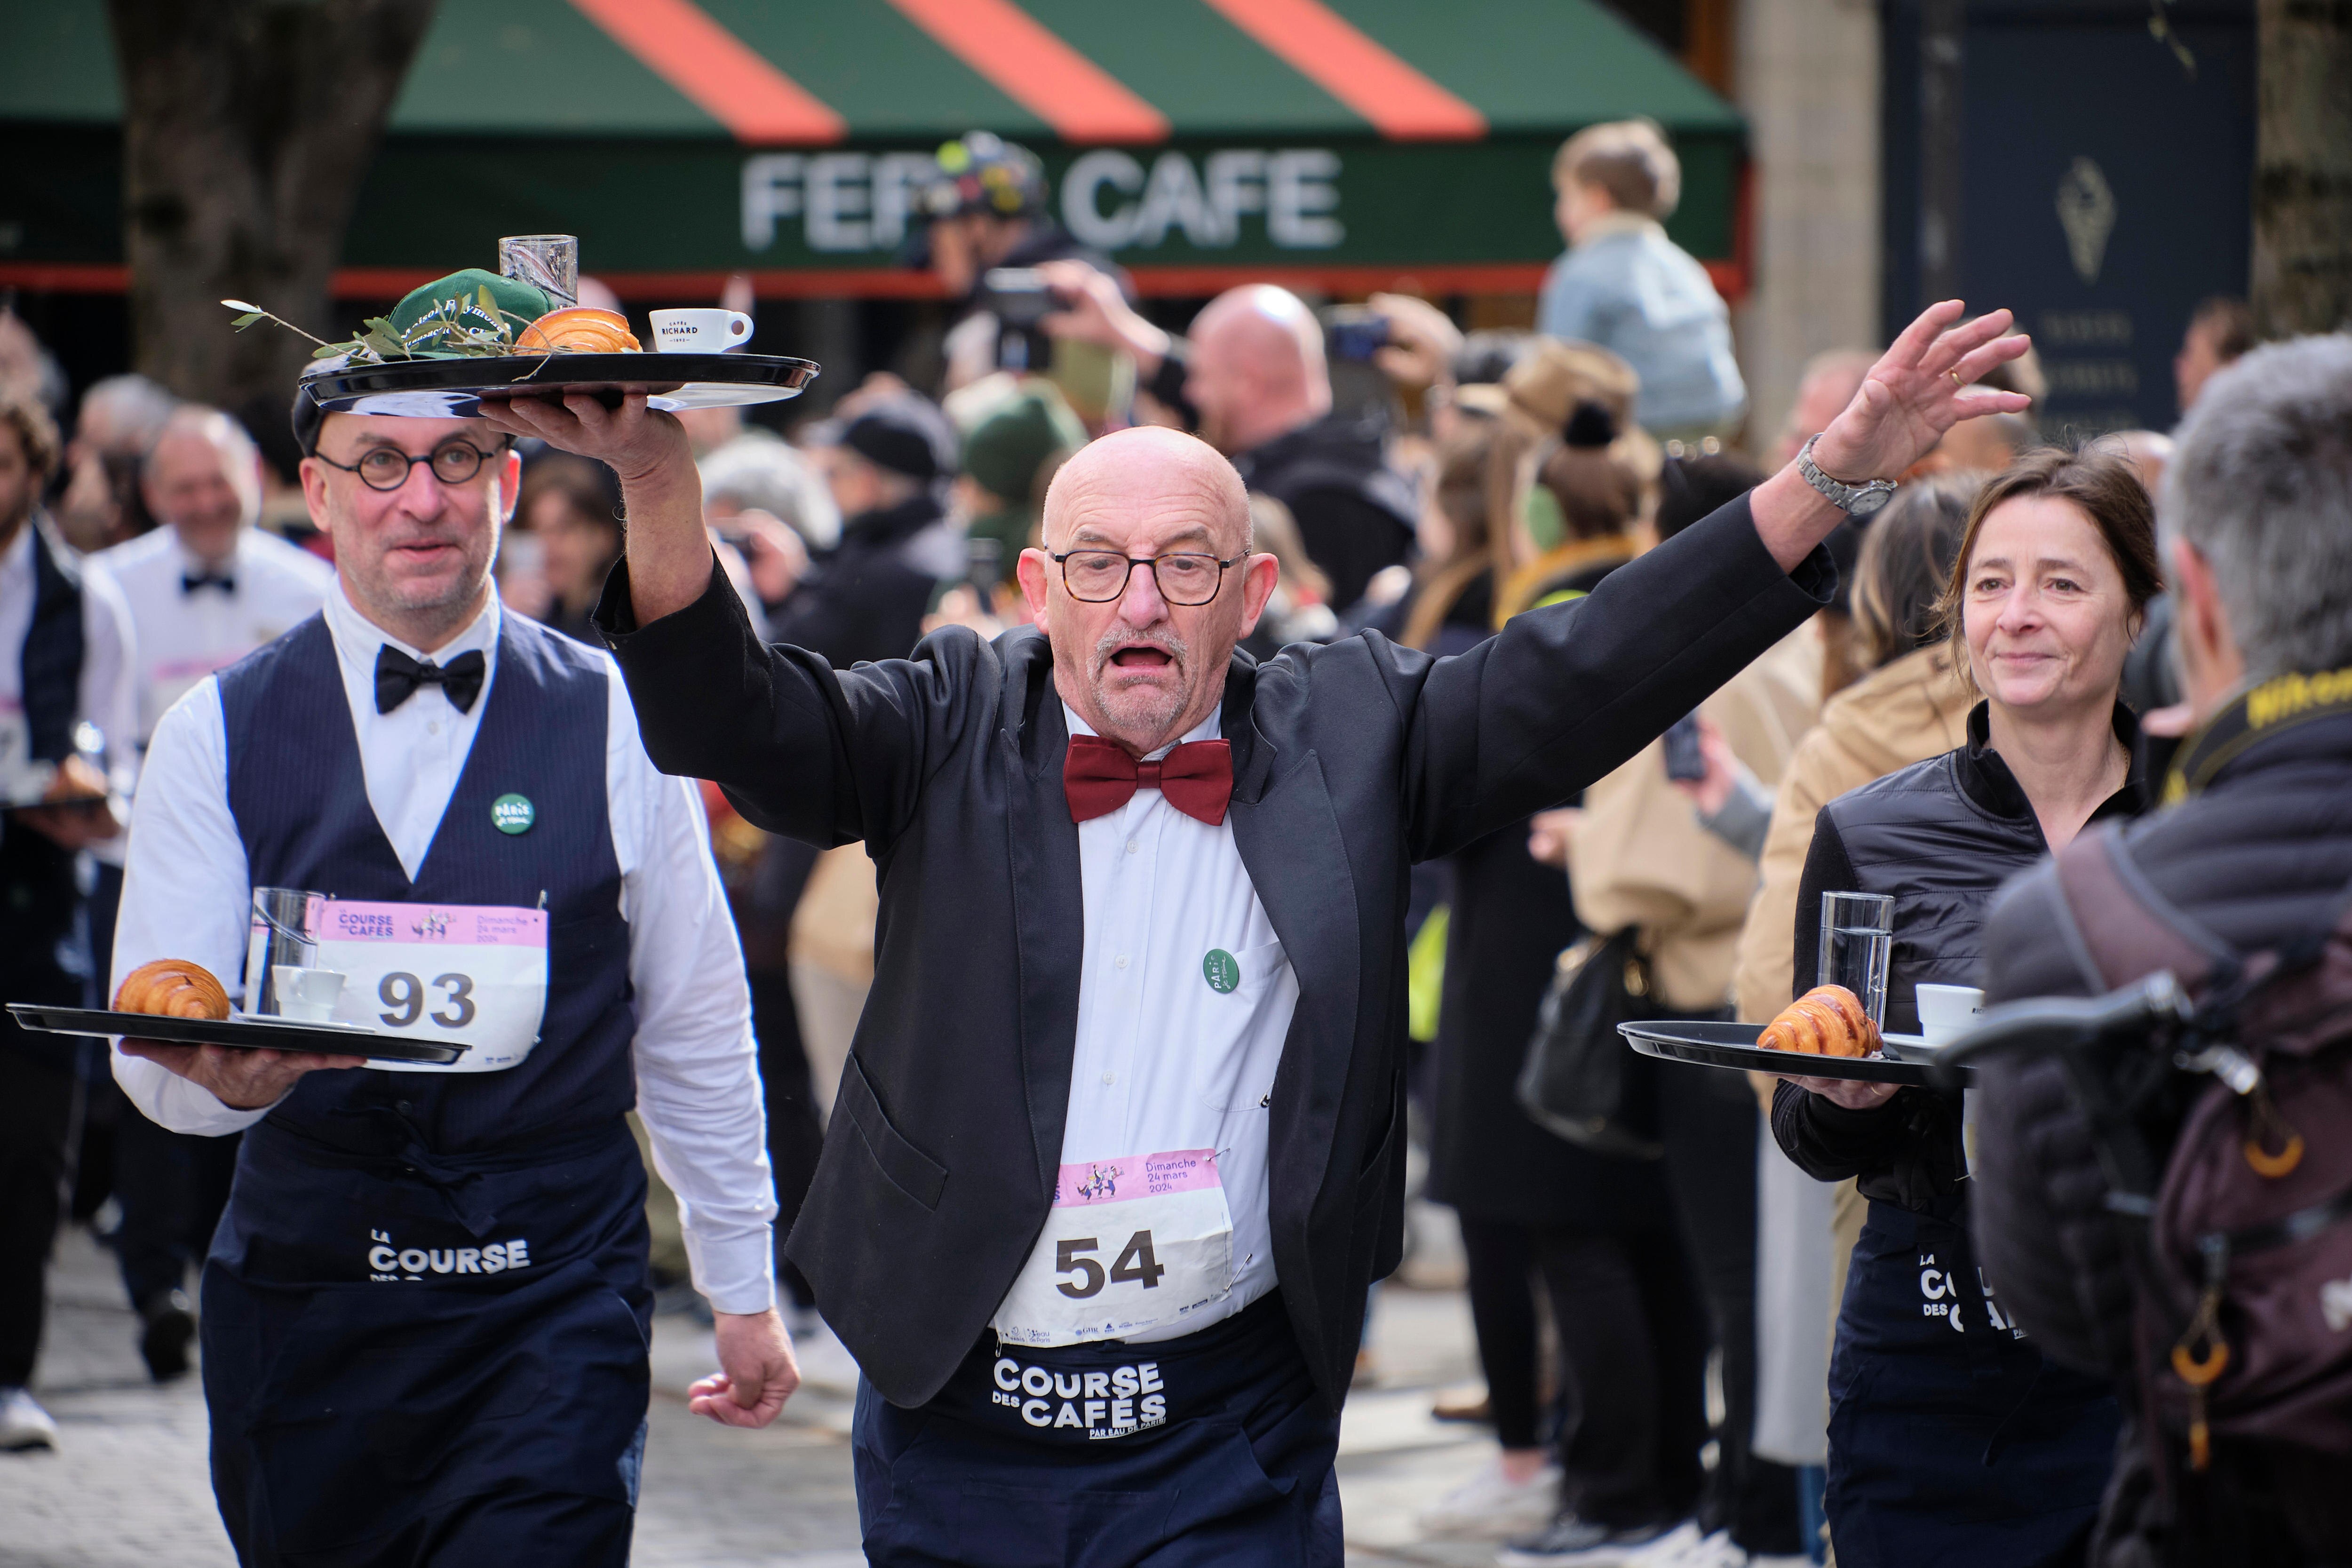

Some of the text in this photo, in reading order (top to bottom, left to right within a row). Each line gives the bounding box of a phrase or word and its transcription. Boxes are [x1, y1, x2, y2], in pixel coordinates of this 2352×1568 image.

[1060, 149, 1346, 249] CAFE
[339, 914, 394, 925] COURSE
[477, 915, 527, 925] Dimanche
[378, 972, 476, 1027] 93
[1146, 1158, 1196, 1172] Dimanche
[1148, 1172, 1188, 1182] 24 mars
[1150, 1183, 1172, 1193] 2024
[371, 1228, 391, 1244] LA
[368, 1239, 531, 1274] COURSE
[1920, 1254, 1935, 1266] LA
[1056, 1230, 1165, 1300] 54
[1923, 1303, 1948, 1316] DES
[993, 1358, 1164, 1399] COURSE
[992, 1391, 1020, 1408] DES
[1089, 1417, 1165, 1437] PAR EAU DE PARIS
